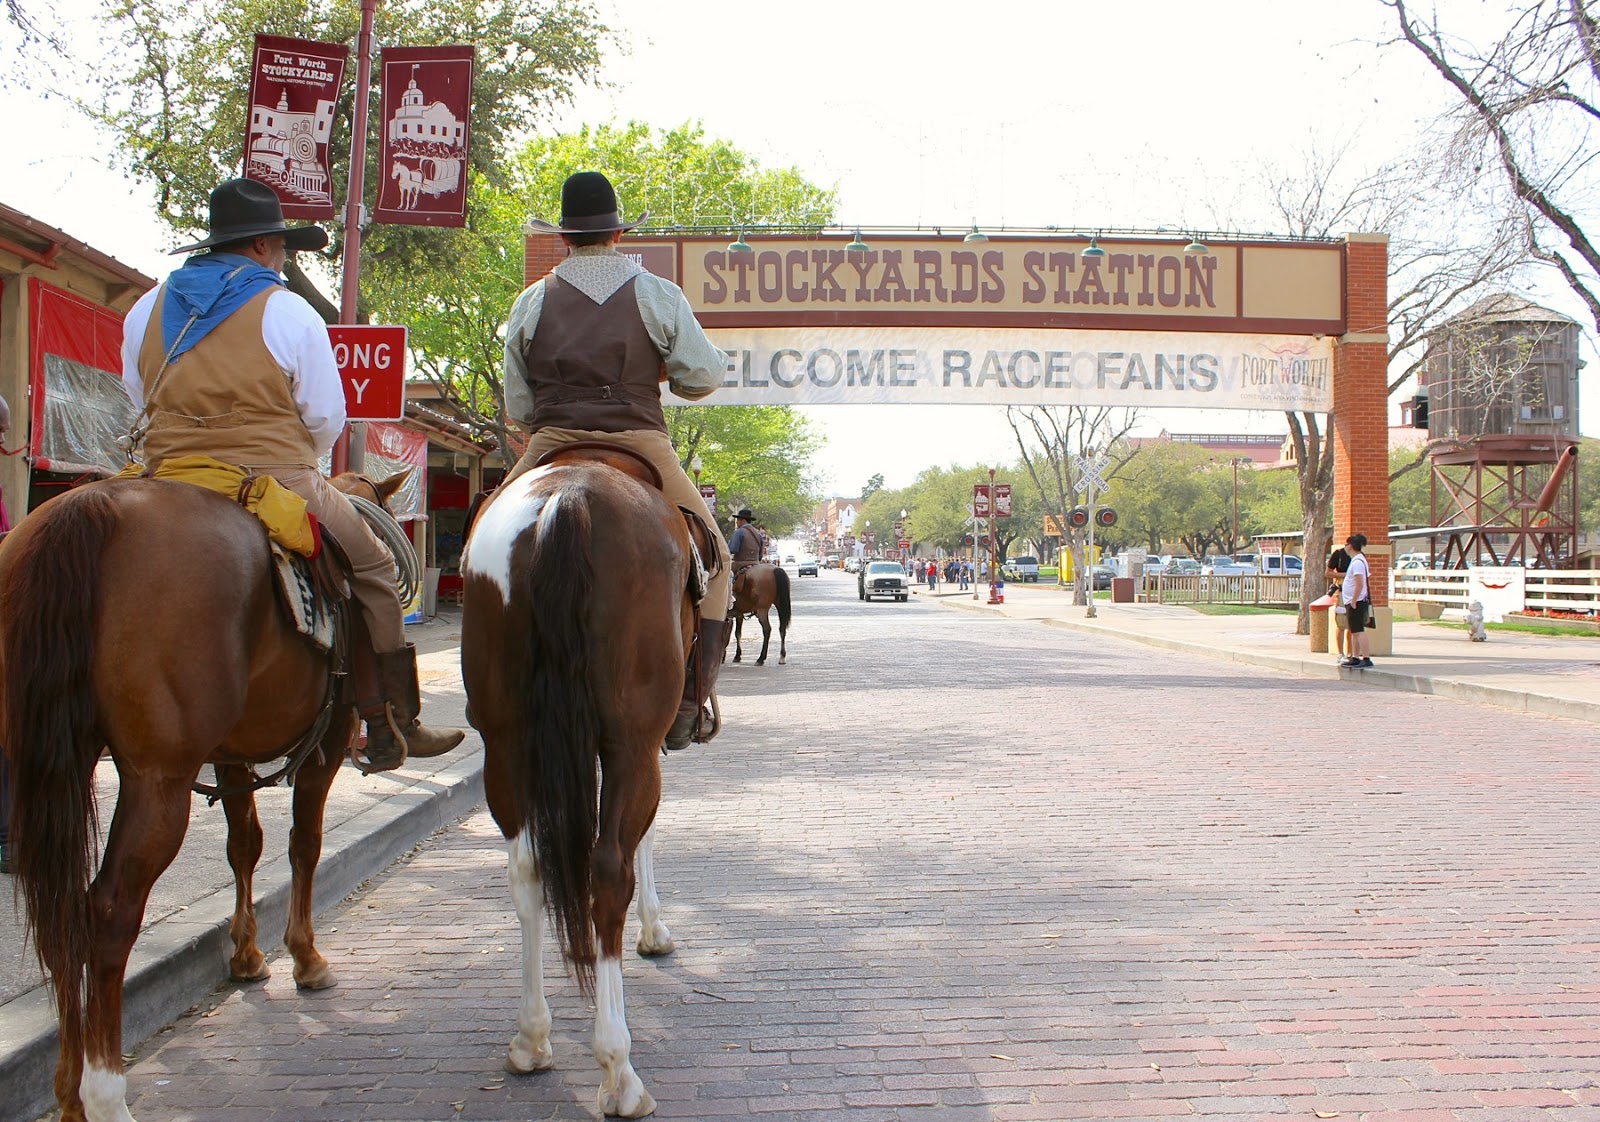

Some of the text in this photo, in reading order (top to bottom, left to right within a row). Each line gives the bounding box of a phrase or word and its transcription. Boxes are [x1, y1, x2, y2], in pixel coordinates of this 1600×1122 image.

[261, 63, 334, 82] STOCKYARDS
[273, 54, 327, 69] Fort Worth
[703, 249, 1218, 308] STOCKYARDS STATION
[333, 343, 391, 369] ONG
[720, 347, 1219, 393] ELCOME RACE FANS
[1241, 353, 1330, 392] FORT WORTH
[1075, 457, 1110, 492] RAIL ROAD
[1076, 458, 1109, 491] CROSSING
